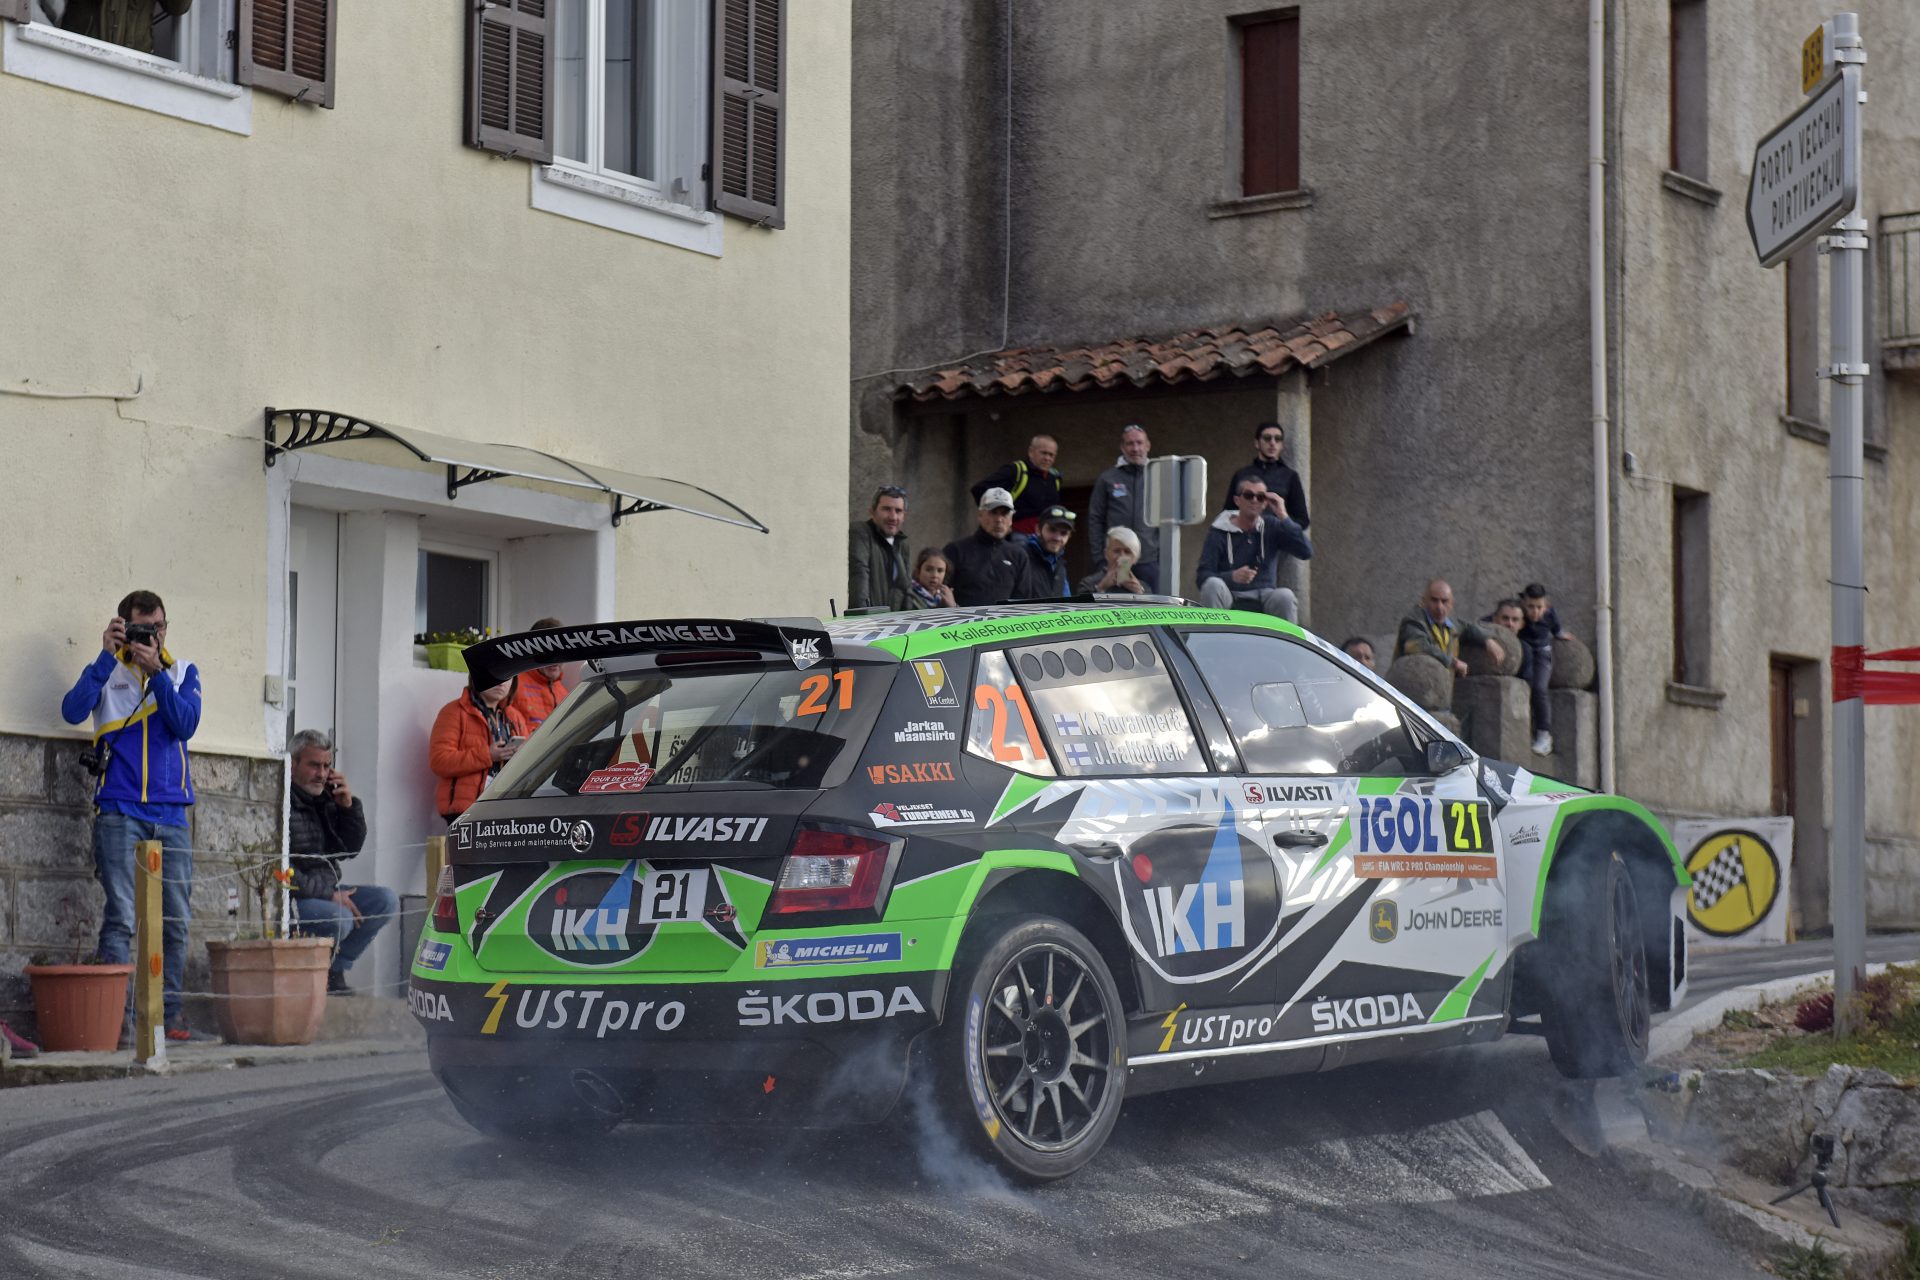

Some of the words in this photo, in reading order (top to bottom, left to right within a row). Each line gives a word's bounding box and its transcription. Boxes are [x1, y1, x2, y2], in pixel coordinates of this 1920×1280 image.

[1760, 140, 1793, 195] PORTO
[1799, 97, 1841, 165] VECCHIO
[496, 625, 736, 659] WWW.HKRACING.EU
[792, 637, 821, 654] HK
[794, 652, 820, 660] RACING
[797, 669, 855, 717] 21
[904, 721, 945, 732] Jarkan
[974, 684, 1048, 763] 21
[896, 803, 934, 811] VELJEKSET
[900, 809, 960, 821] TURPEINEN
[960, 809, 974, 819] Ky
[475, 819, 546, 837] Laivakone
[550, 817, 572, 837] Oy
[1358, 797, 1439, 854] IGOL
[1451, 802, 1483, 850] 21
[475, 841, 487, 850] Ship
[489, 840, 512, 848] Service
[514, 839, 525, 847] and
[528, 838, 572, 847] maintenance
[1390, 861, 1405, 871] WRC
[1405, 861, 1411, 871] 2
[1411, 861, 1423, 871] PRO
[1424, 861, 1465, 873] Championship
[651, 872, 690, 920] 21
[1404, 909, 1448, 932] JOHN
[1451, 907, 1502, 928] DEERE
[793, 942, 889, 959] MICHELIN
[737, 985, 927, 1026] ŠKODA
[1311, 992, 1424, 1032] ŠKODA
